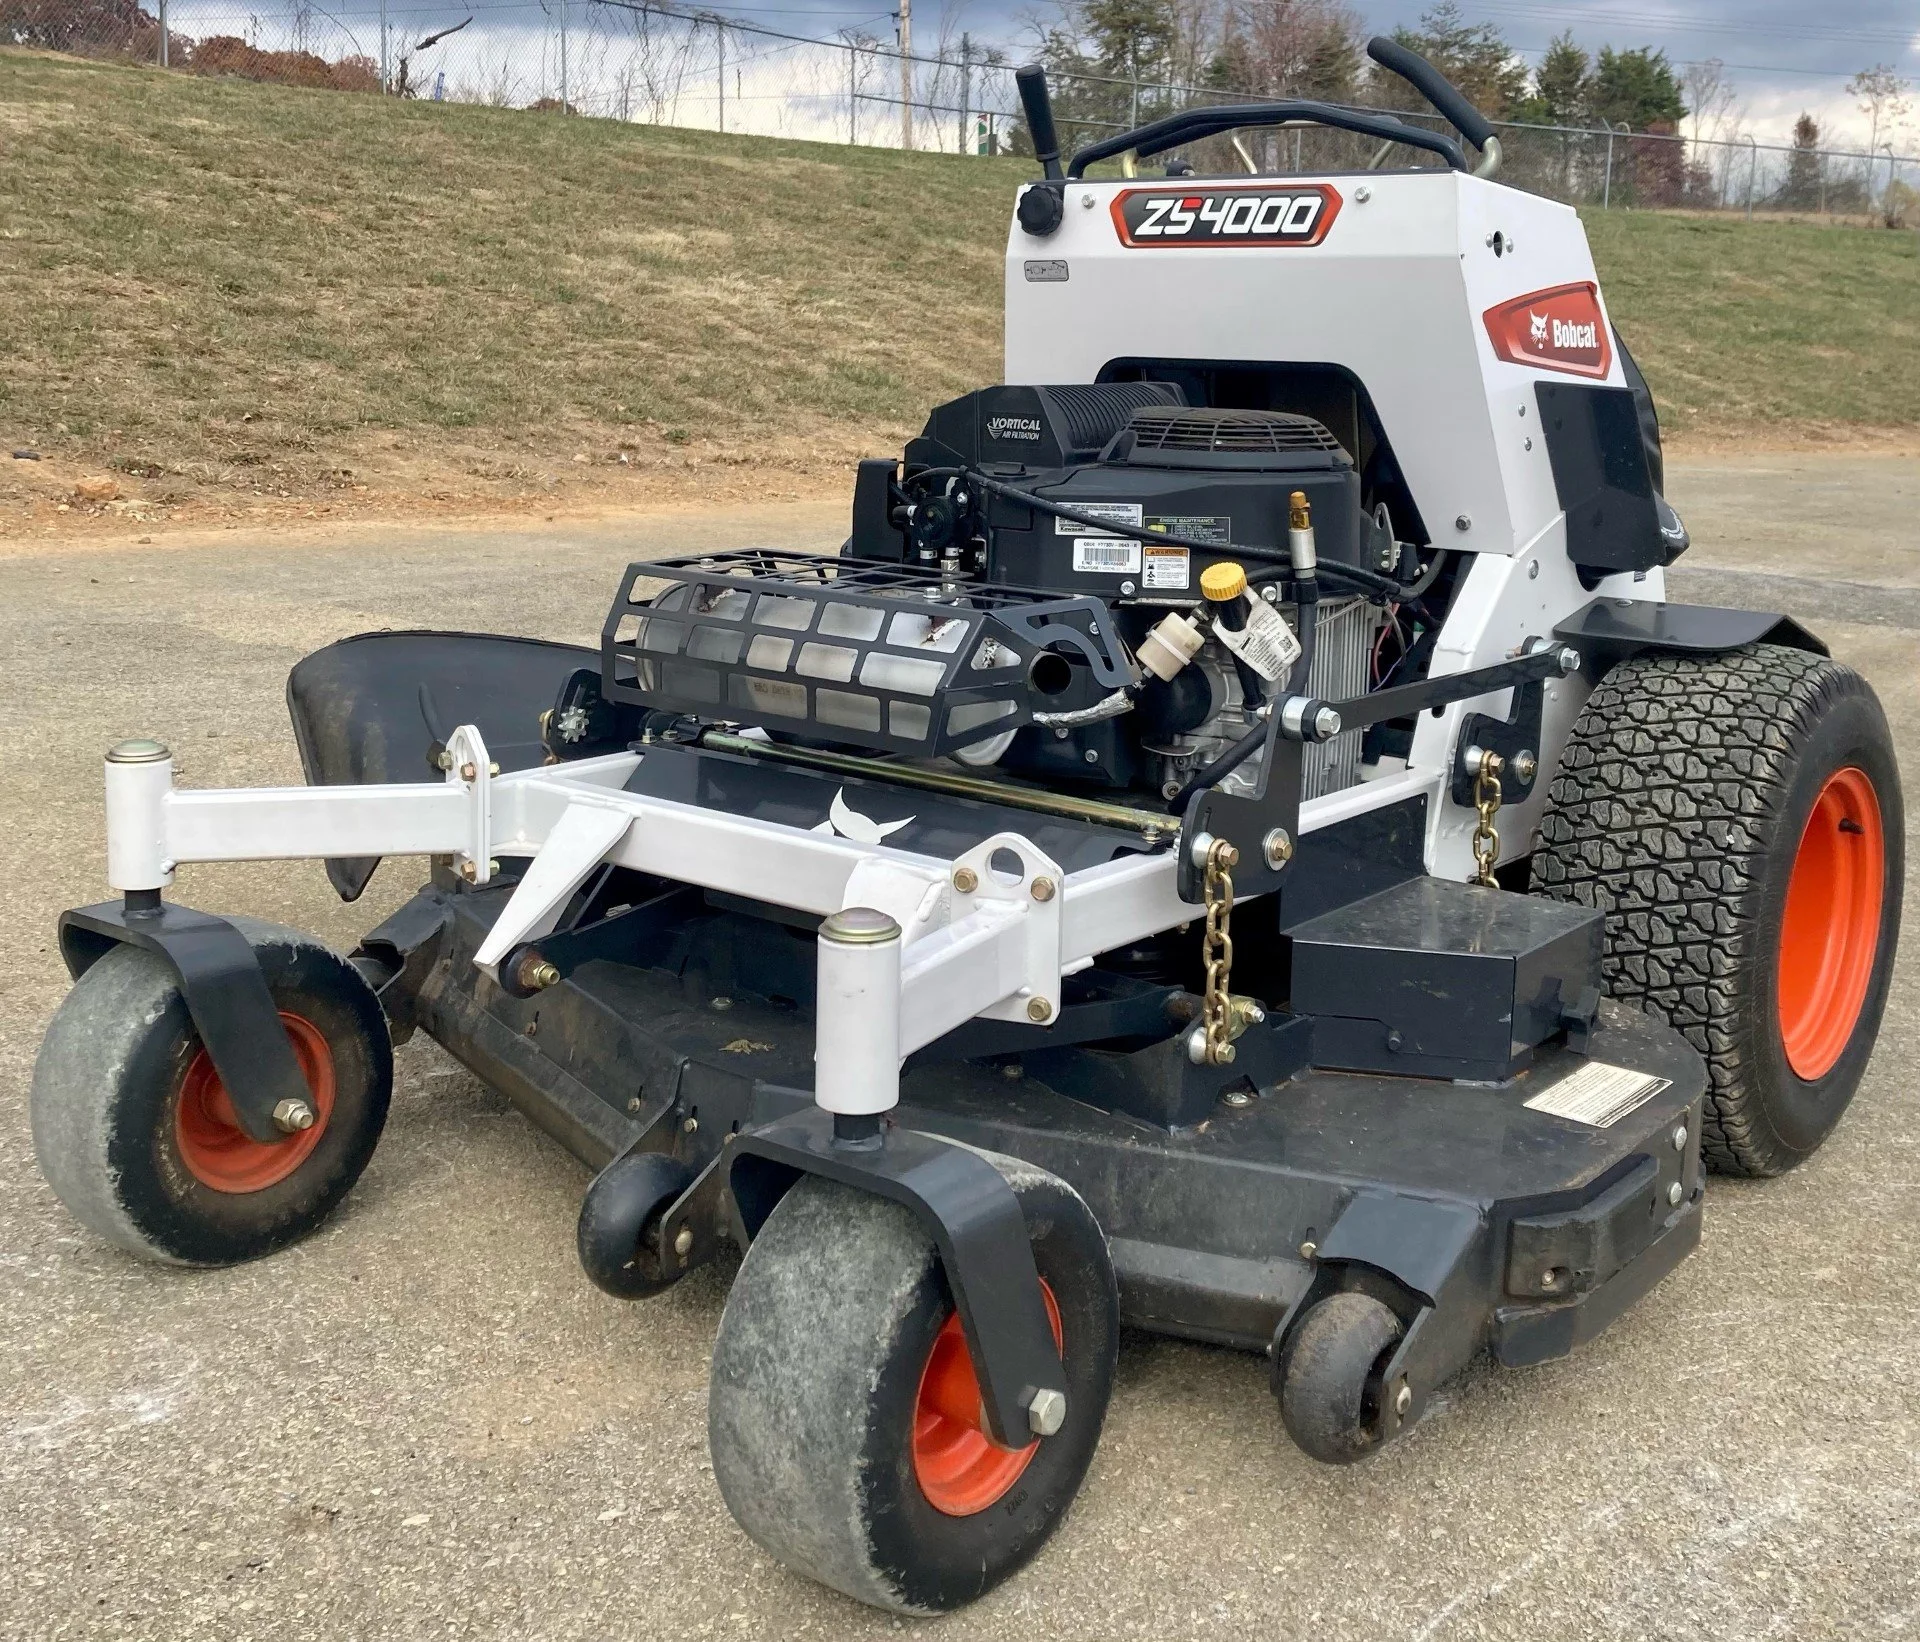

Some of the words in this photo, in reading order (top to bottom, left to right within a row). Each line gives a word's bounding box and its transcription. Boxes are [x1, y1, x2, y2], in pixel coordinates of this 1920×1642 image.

[1134, 196, 1323, 236] ZS4000
[1552, 319, 1597, 349] Bobcat
[992, 417, 1041, 431] VORTICAL
[1001, 430, 1011, 439] AIR
[1011, 431, 1040, 441] FILTRATION
